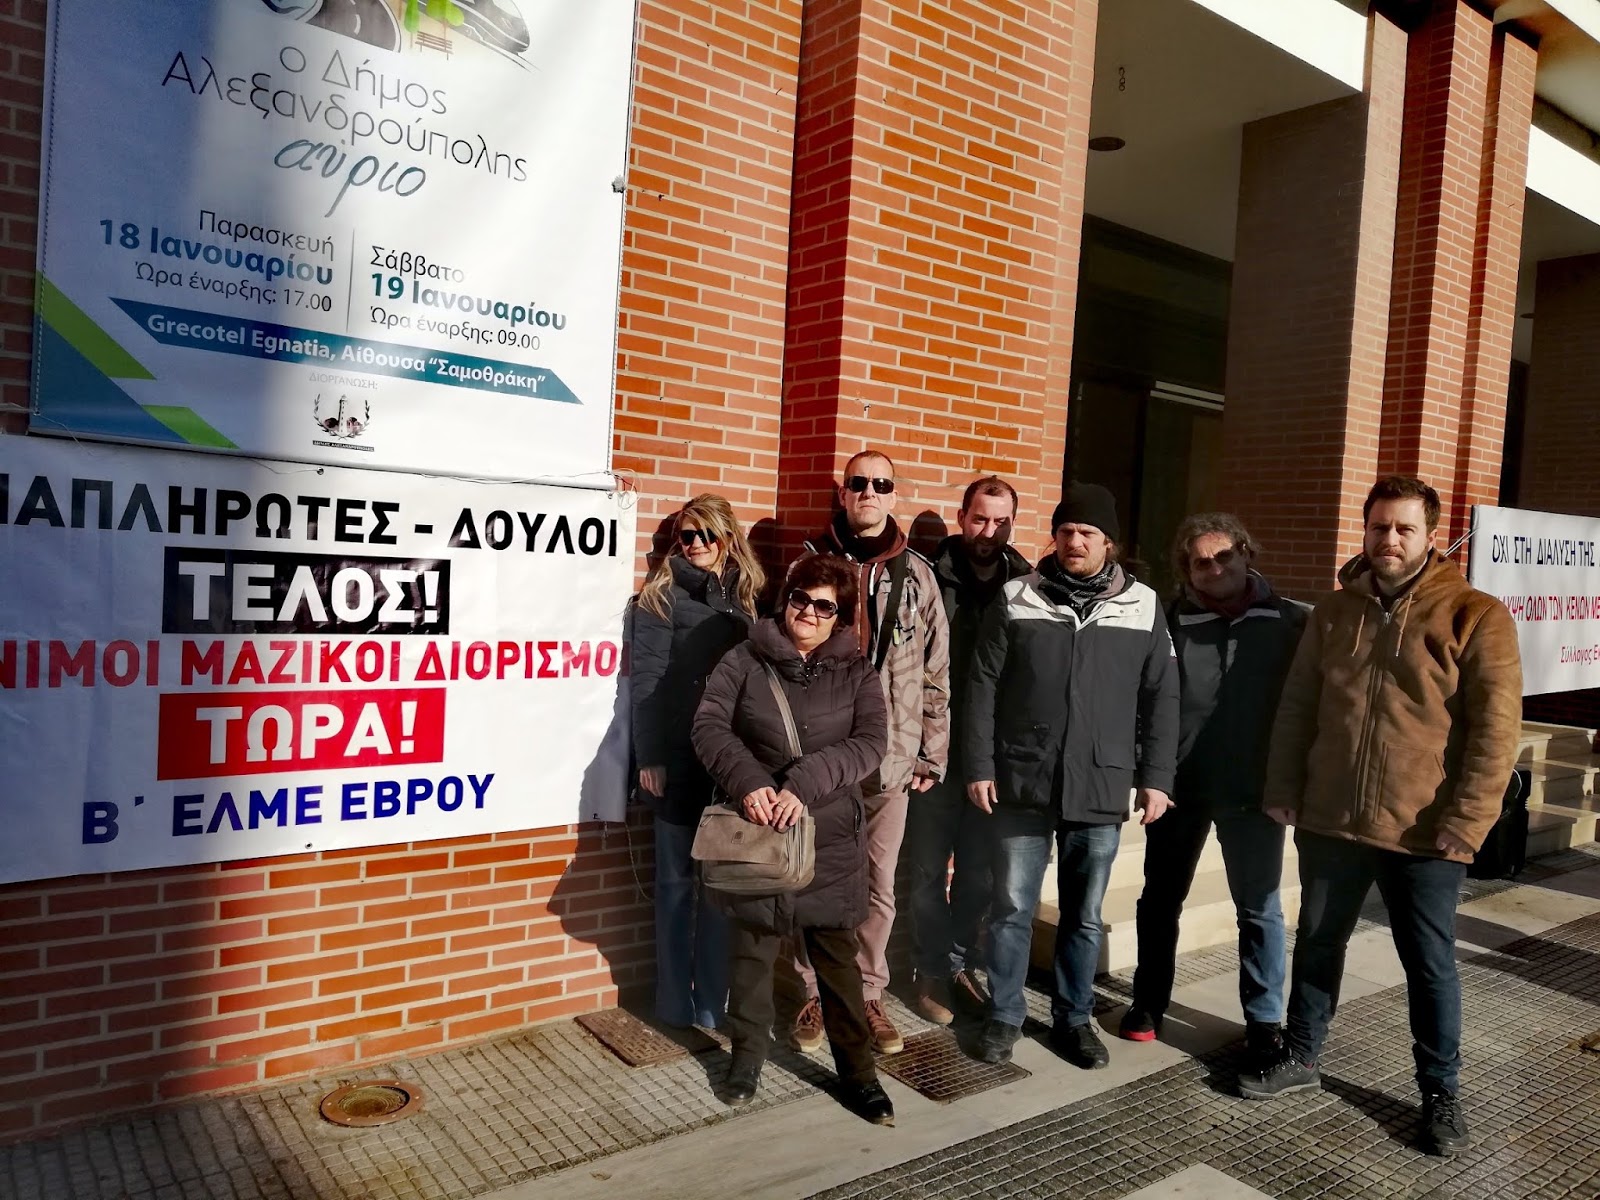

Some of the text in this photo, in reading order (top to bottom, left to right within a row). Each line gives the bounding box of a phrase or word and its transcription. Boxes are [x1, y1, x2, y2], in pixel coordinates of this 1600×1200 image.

[321, 49, 447, 116] Δήμος
[161, 50, 528, 182] Αλεξανδρούπολης
[99, 218, 333, 285] 18 Ιανουαρίου
[199, 209, 334, 262] Παρασκευή
[370, 245, 465, 284] Σάββατο
[135, 260, 332, 312] Ώρα έναρξης: 17.00
[371, 272, 567, 331] 19 Ιανουαρίου
[147, 313, 245, 345] Grecotel
[251, 330, 336, 360] Egnatia,
[341, 343, 426, 373] Αίθουσα
[370, 305, 541, 350] Ώρα έναρξης: 09.00
[309, 372, 378, 389] ΔΙΟΡΓΑΝΩΣΗ:
[0, 473, 399, 544] ΑΠΛΗΡΩΤΕΣ
[448, 507, 618, 557] ΔΟΥΛΟΙ
[1492, 534, 1595, 567] ΟΧΙ ΣΤΗ ΔΙΑΛΥΣΗ ΤΗΣ
[179, 560, 441, 624] ΤΕΛΟΣ!
[1526, 595, 1547, 621] ΟΛΩΝ
[1548, 596, 1563, 620] ΤΩΝ
[181, 640, 400, 686] ΜΑΖΙΚΟΙ
[196, 701, 417, 765] ΤΩΡΑ!
[172, 785, 323, 837] ΕΛΜΕ
[340, 773, 495, 822] ΕΒΡΟΥ
